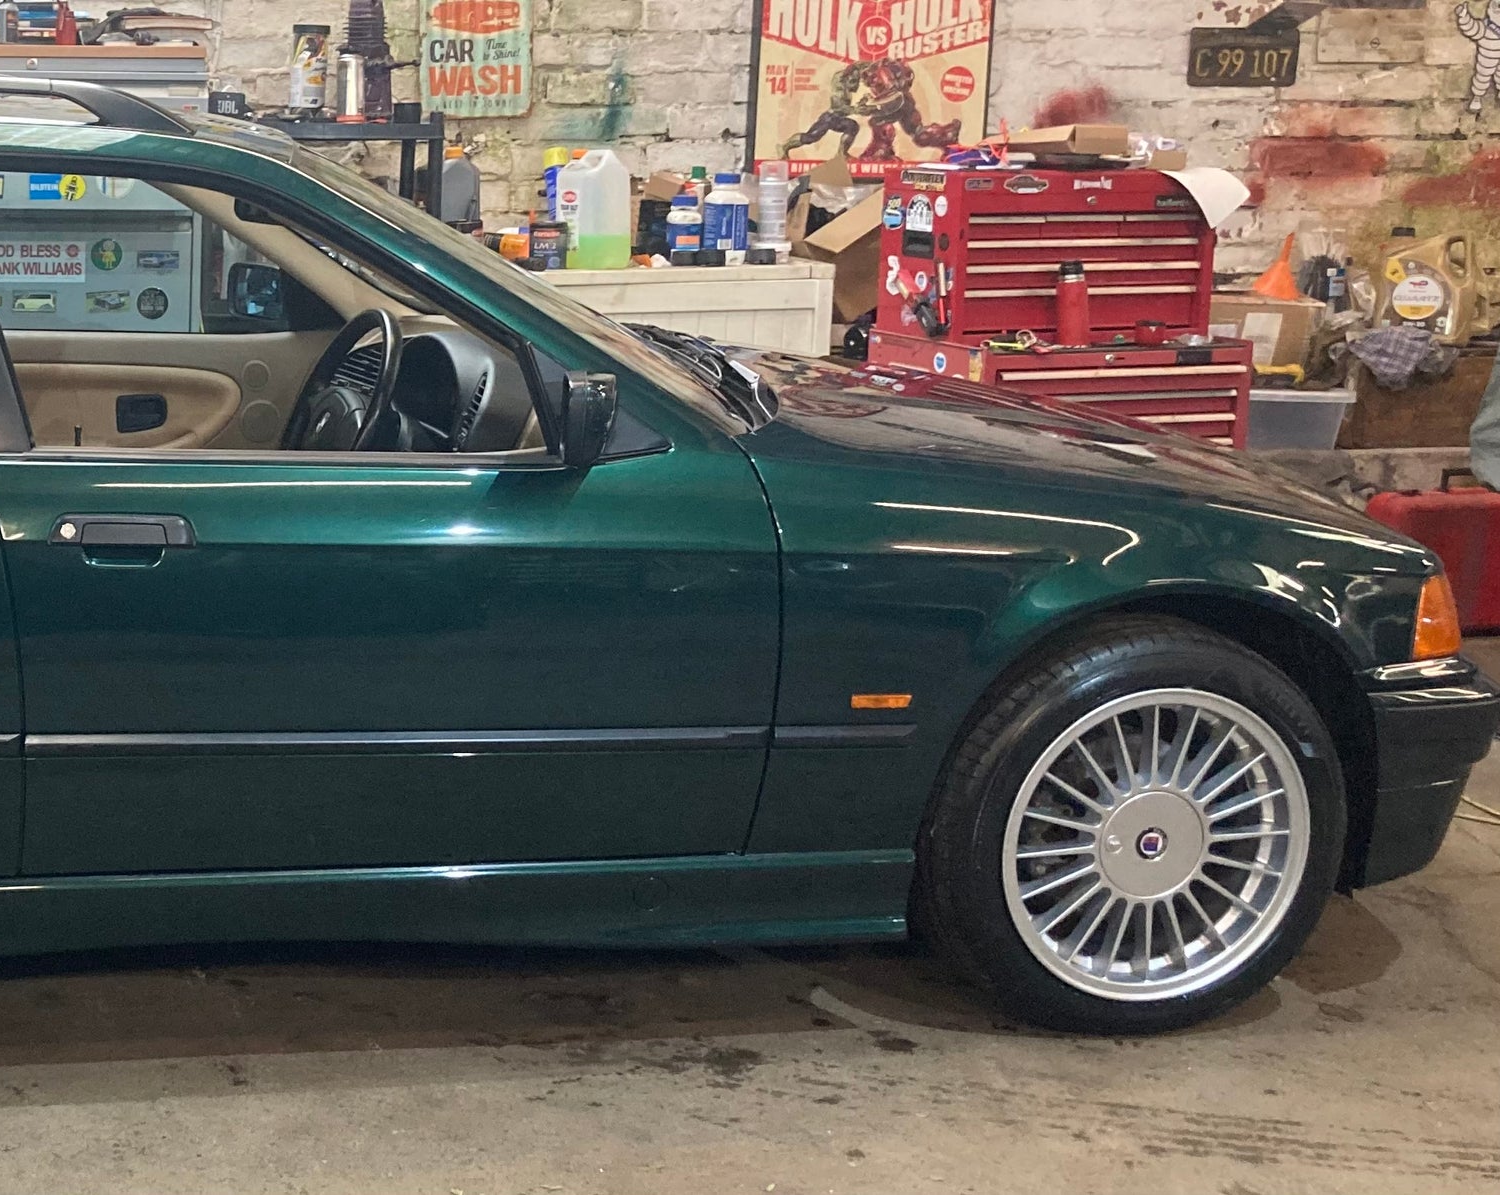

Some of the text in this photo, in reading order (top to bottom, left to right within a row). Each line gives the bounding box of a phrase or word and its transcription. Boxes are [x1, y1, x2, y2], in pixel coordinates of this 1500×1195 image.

[768, 0, 863, 61] HULK
[891, 0, 984, 41] HULK
[485, 38, 507, 50] Time
[865, 26, 888, 46] VS
[888, 20, 983, 60] BUSTER
[429, 39, 475, 63] CAR
[493, 48, 521, 60] Shine!
[1195, 48, 1292, 78] C 99 107
[428, 64, 522, 97] WASH
[218, 100, 238, 115] JBL
[20, 244, 61, 258] BLESS
[23, 262, 83, 275] WILLIAMS
